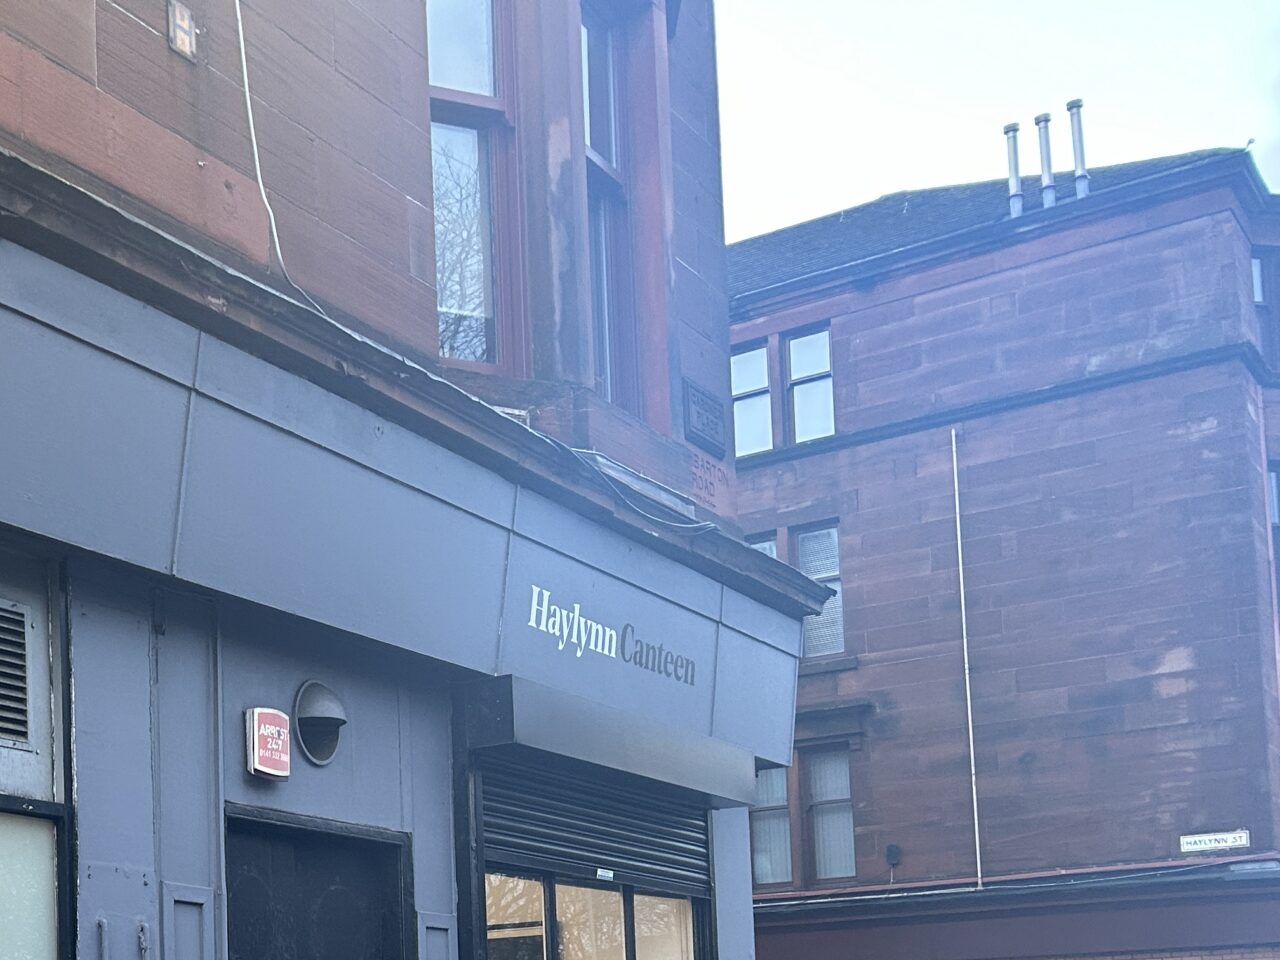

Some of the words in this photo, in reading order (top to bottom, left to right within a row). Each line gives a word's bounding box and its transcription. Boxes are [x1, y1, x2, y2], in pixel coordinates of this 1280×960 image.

[691, 471, 715, 497] ROAD
[527, 584, 618, 658] Haylynn
[621, 623, 696, 686] Canteen
[260, 749, 271, 758] 0141
[1185, 837, 1228, 847] HAYLYNN
[1231, 835, 1244, 844] ST
